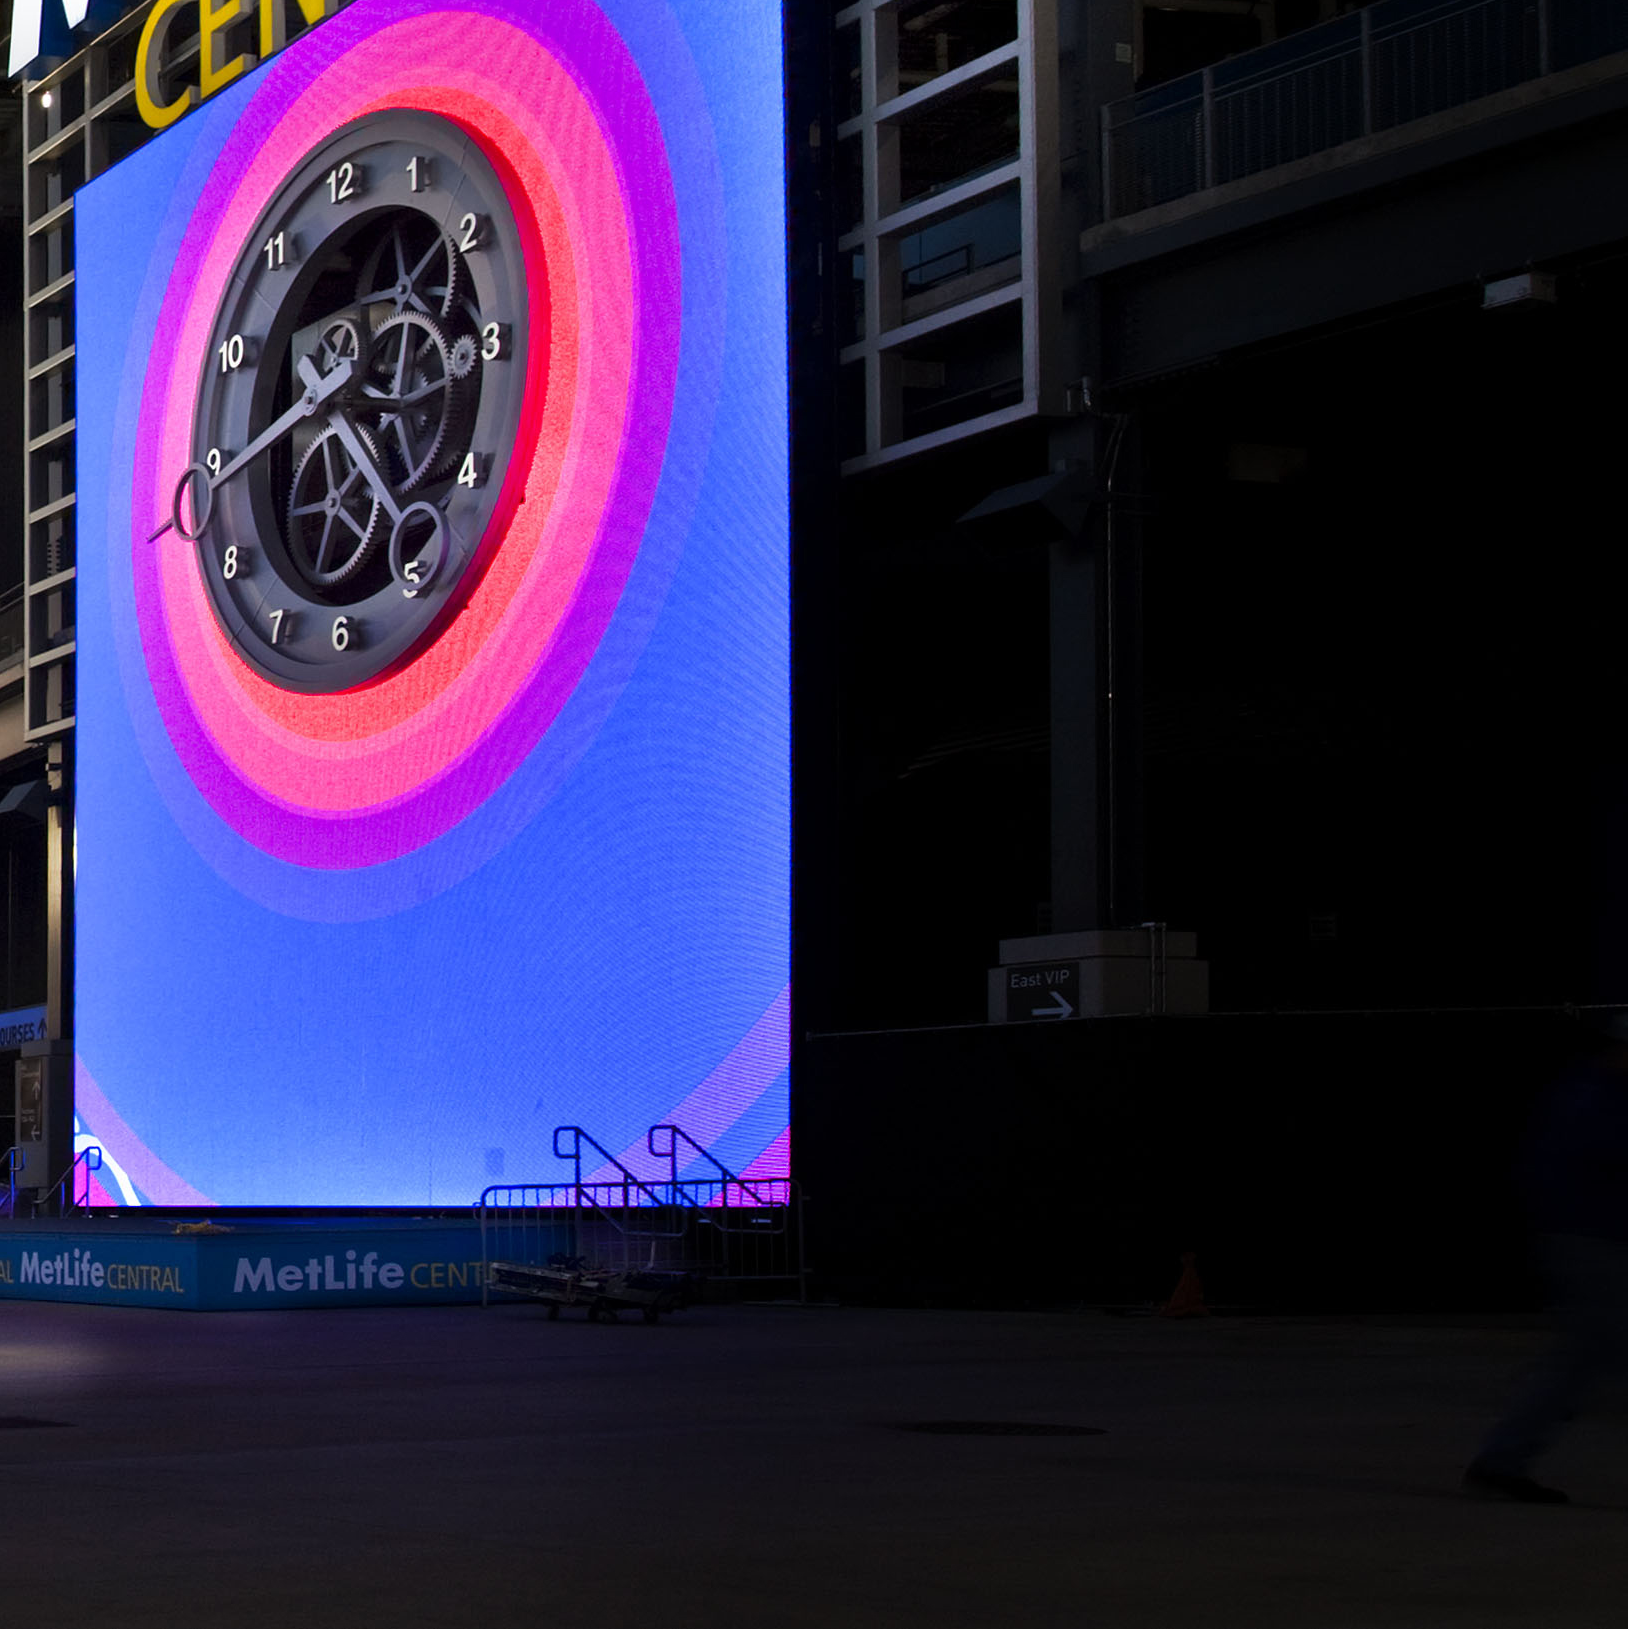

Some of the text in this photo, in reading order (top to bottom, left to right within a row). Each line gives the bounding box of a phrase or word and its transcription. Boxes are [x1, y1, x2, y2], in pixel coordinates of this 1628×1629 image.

[326, 162, 354, 204] 12
[406, 156, 418, 192] 1
[264, 231, 284, 270] 11
[459, 212, 478, 253] 2
[218, 334, 244, 373] 10
[481, 322, 501, 361] 3
[206, 447, 221, 476] 9
[457, 451, 478, 489] 4
[223, 545, 238, 580] 8
[269, 609, 284, 644] 7
[331, 616, 349, 652] 6
[1010, 969, 1070, 988] East VIP
[20, 1247, 105, 1288] MetLife
[106, 1263, 185, 1293] CENTRAL
[233, 1249, 405, 1293] MetLife
